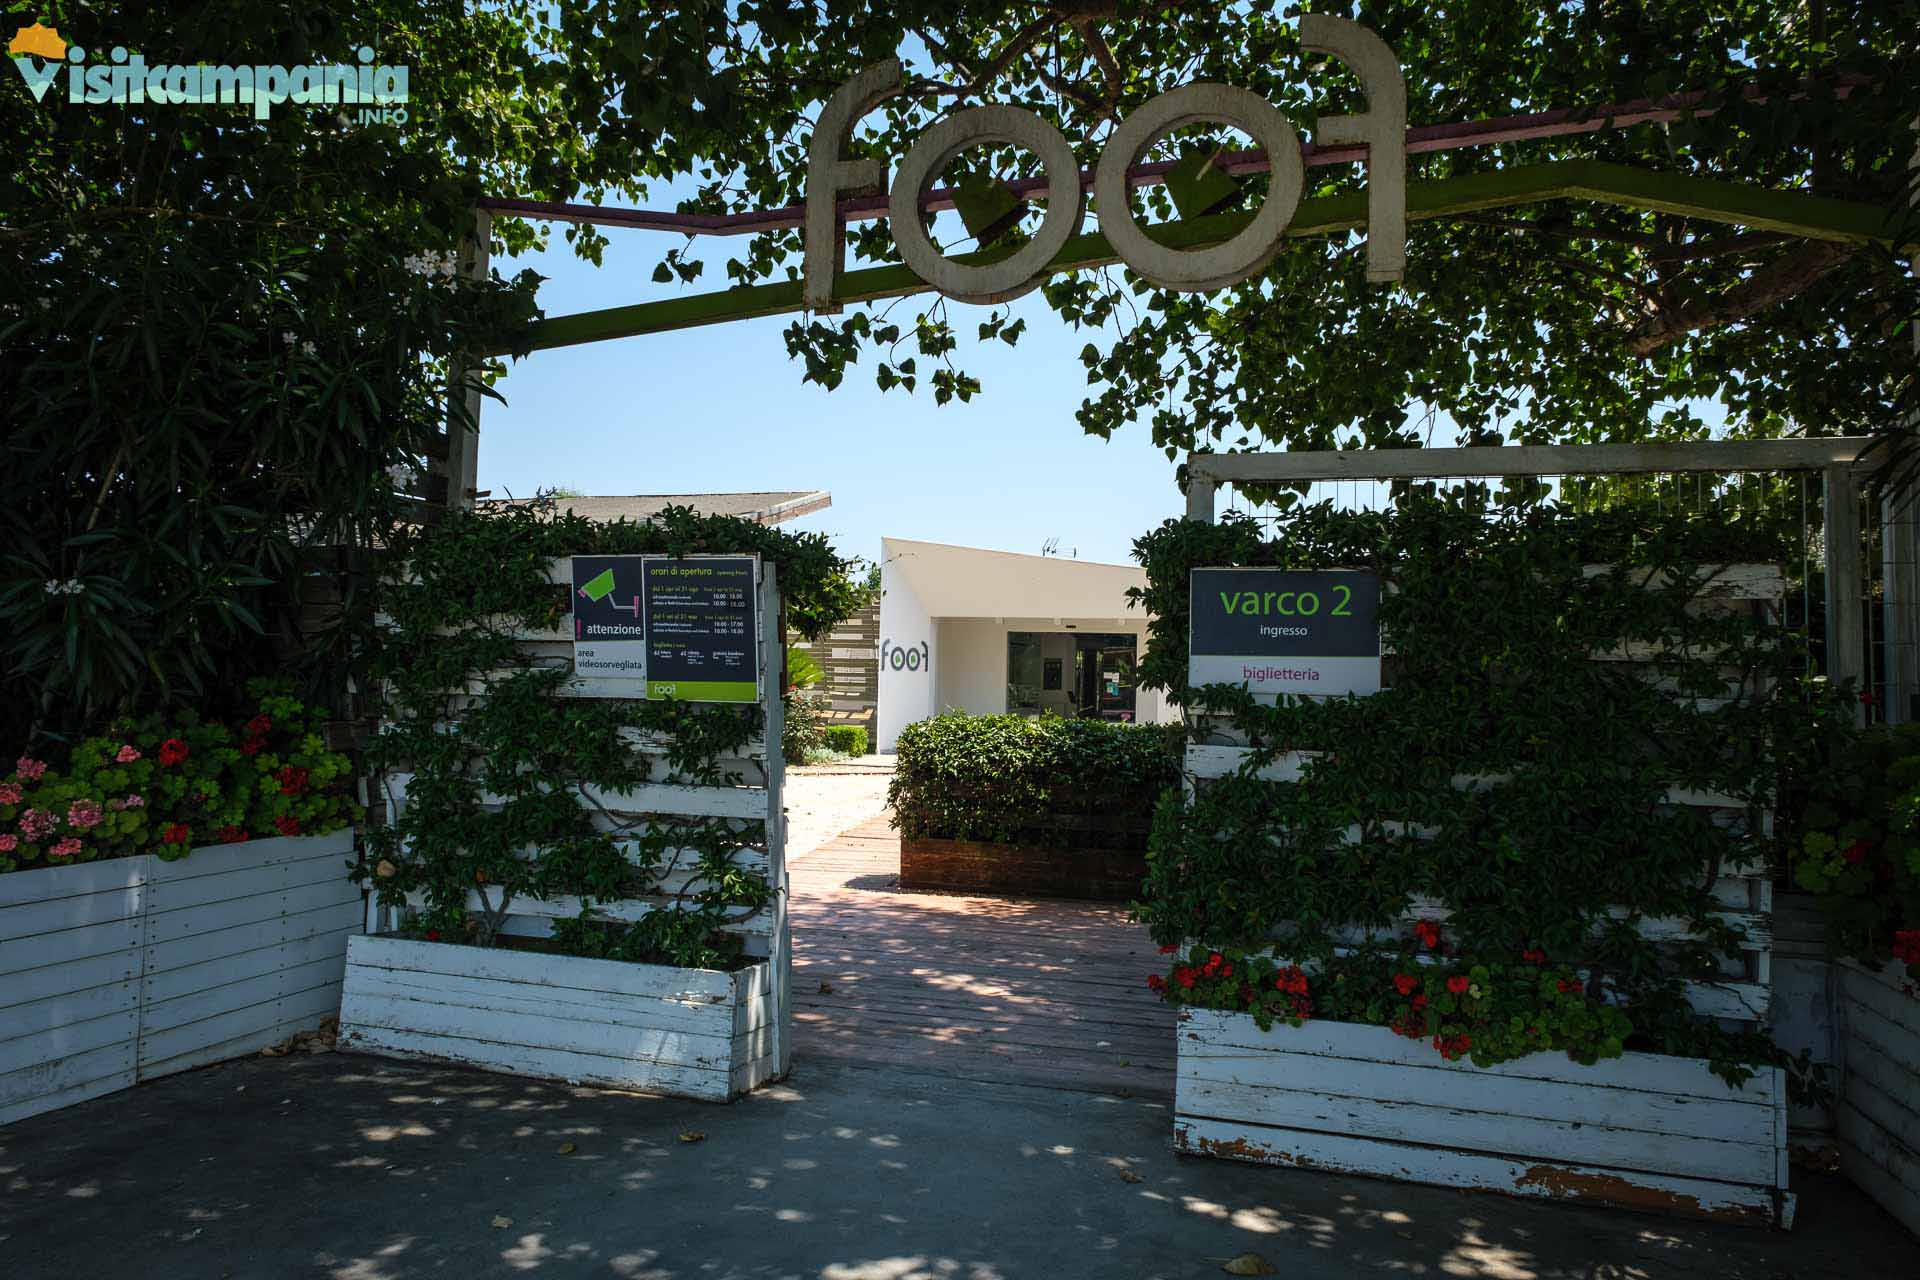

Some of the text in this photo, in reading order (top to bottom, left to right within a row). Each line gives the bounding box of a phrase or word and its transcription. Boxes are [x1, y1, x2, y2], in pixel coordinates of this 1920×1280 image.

[1218, 585, 1353, 617] varco 2
[586, 623, 641, 636] attenzione
[1259, 624, 1308, 638] ingresso
[577, 650, 594, 658] area
[577, 659, 642, 671] videosorvegliata
[1242, 664, 1320, 682] biglietteria
